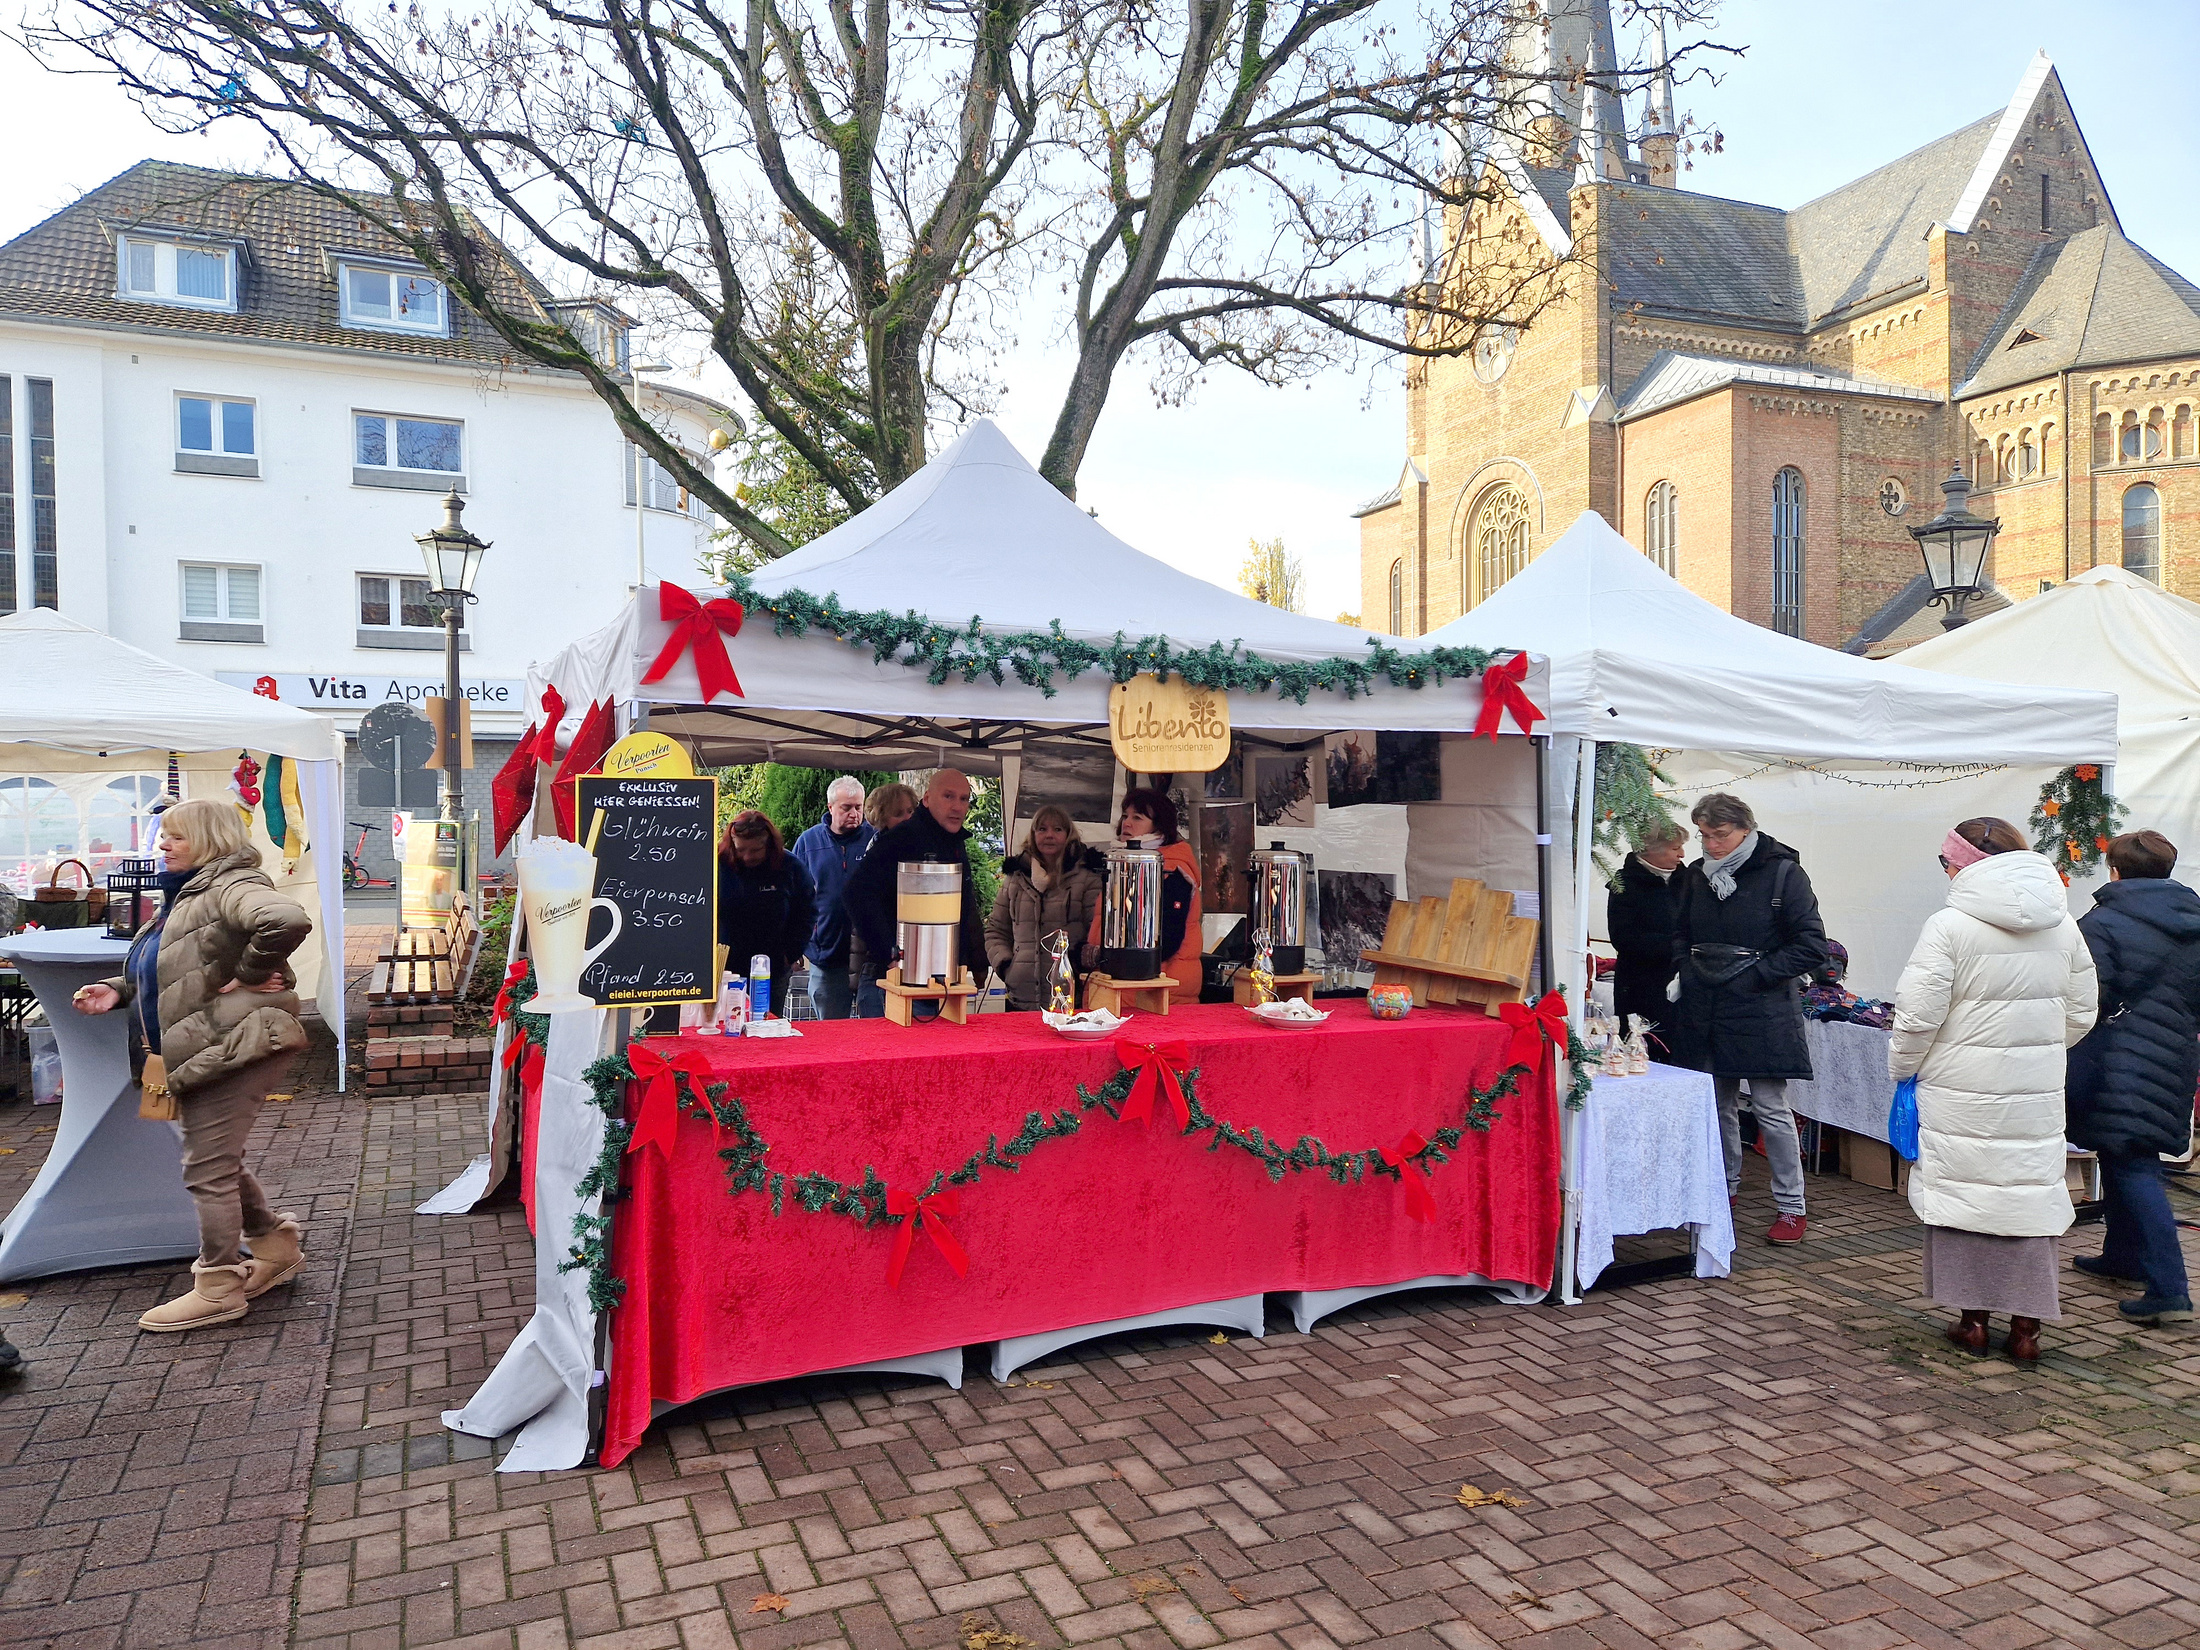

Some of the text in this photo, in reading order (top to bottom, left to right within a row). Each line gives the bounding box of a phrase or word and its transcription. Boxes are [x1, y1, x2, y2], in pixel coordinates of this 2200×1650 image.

[308, 676, 367, 699] Vita
[1118, 701, 1226, 741] Libento
[610, 742, 670, 769] Verpoorten
[1132, 743, 1214, 753] Seniorenresidenzen
[635, 763, 657, 774] Punsch
[603, 813, 708, 840] Glühwein
[628, 843, 677, 862] 2.50
[599, 877, 706, 909] Eierpunsch
[534, 898, 582, 920] Verpoorten
[632, 910, 683, 928] 3.50
[585, 962, 695, 993] Pfand 2.50
[608, 985, 702, 1000] eieiei.verpoorten.de
